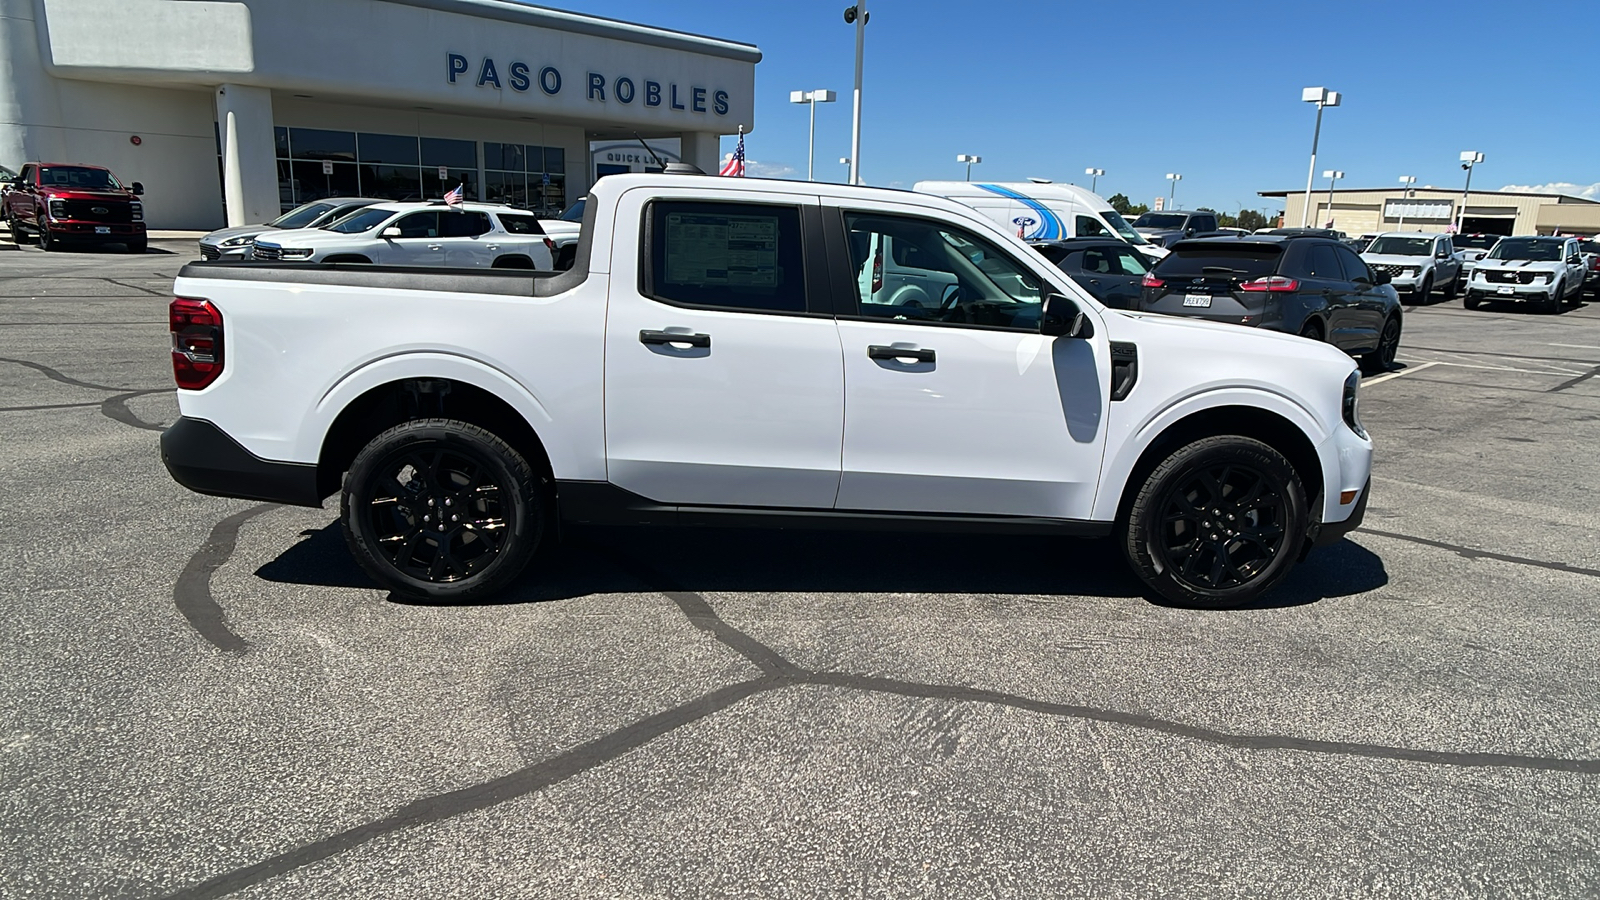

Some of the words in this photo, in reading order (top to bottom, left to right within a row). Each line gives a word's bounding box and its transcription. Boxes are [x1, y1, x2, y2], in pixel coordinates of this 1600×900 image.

[447, 52, 562, 96] PASO
[586, 71, 730, 116] ROBLES
[607, 153, 640, 163] QUICK
